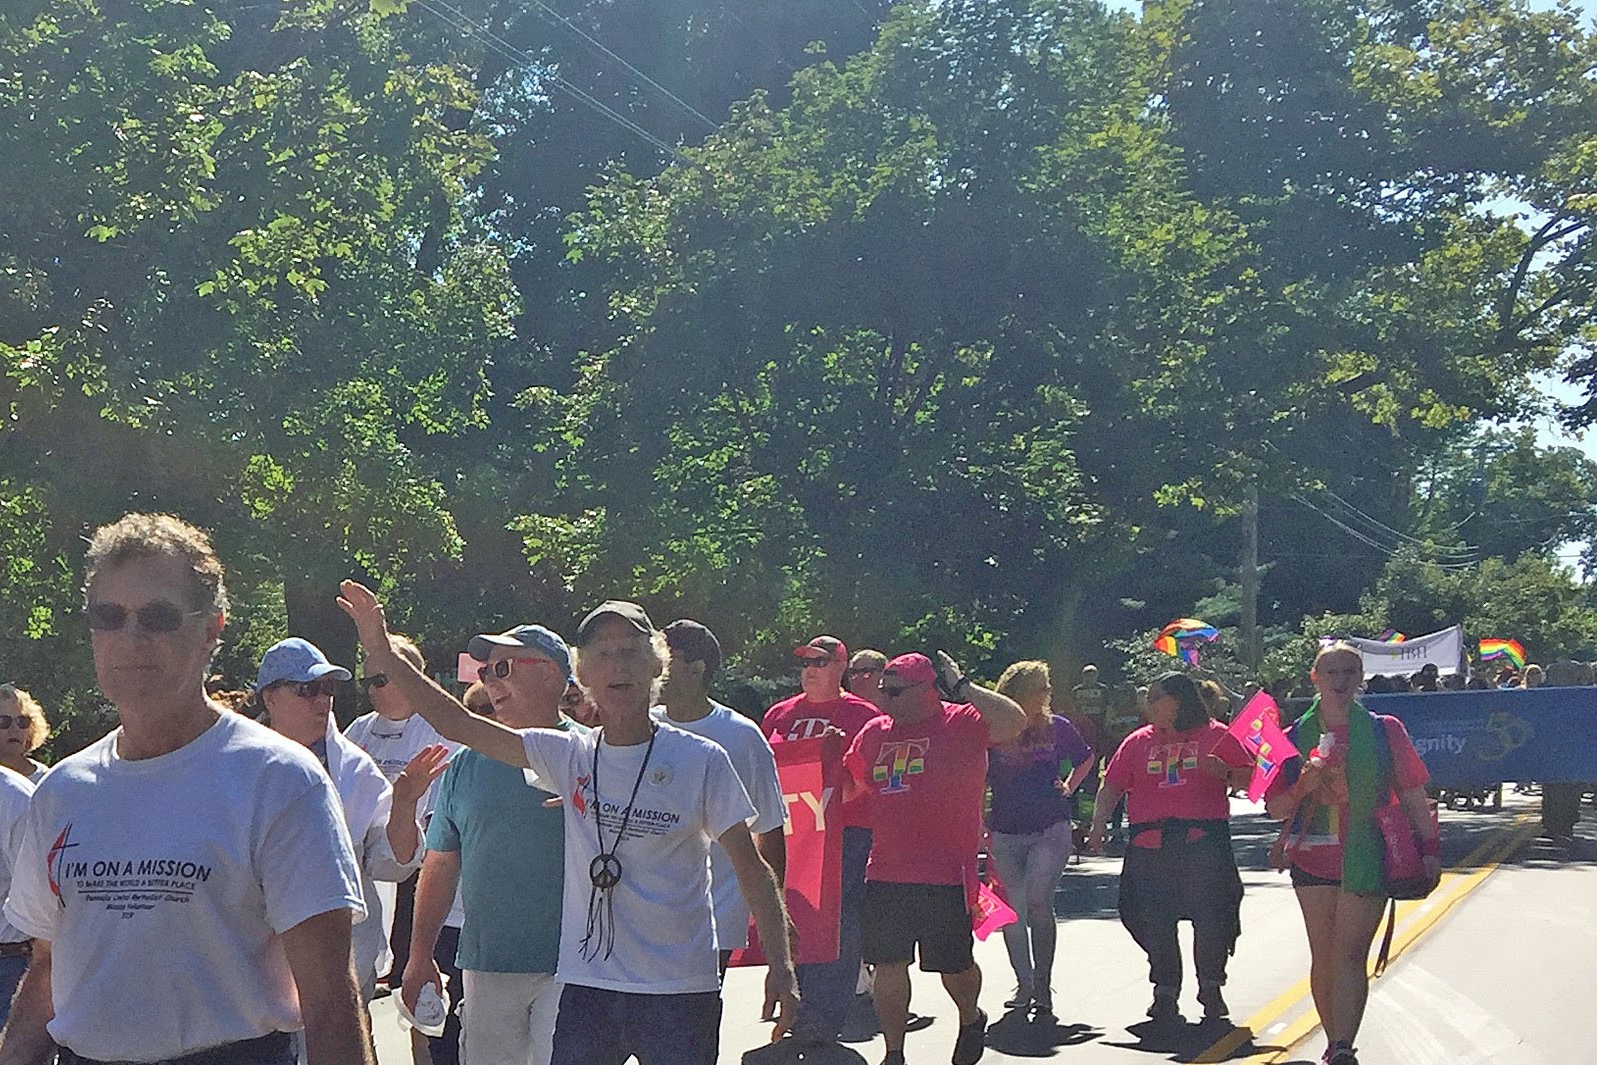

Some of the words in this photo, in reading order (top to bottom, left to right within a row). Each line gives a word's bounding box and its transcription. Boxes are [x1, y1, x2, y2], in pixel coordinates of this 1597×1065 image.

[1411, 733, 1468, 756] gnity
[603, 803, 619, 814] ON
[632, 808, 680, 823] MISSION
[783, 787, 834, 836] TY
[65, 862, 88, 878] I'M
[93, 861, 120, 877] ON
[123, 861, 133, 876] A
[137, 860, 211, 882] MISSION
